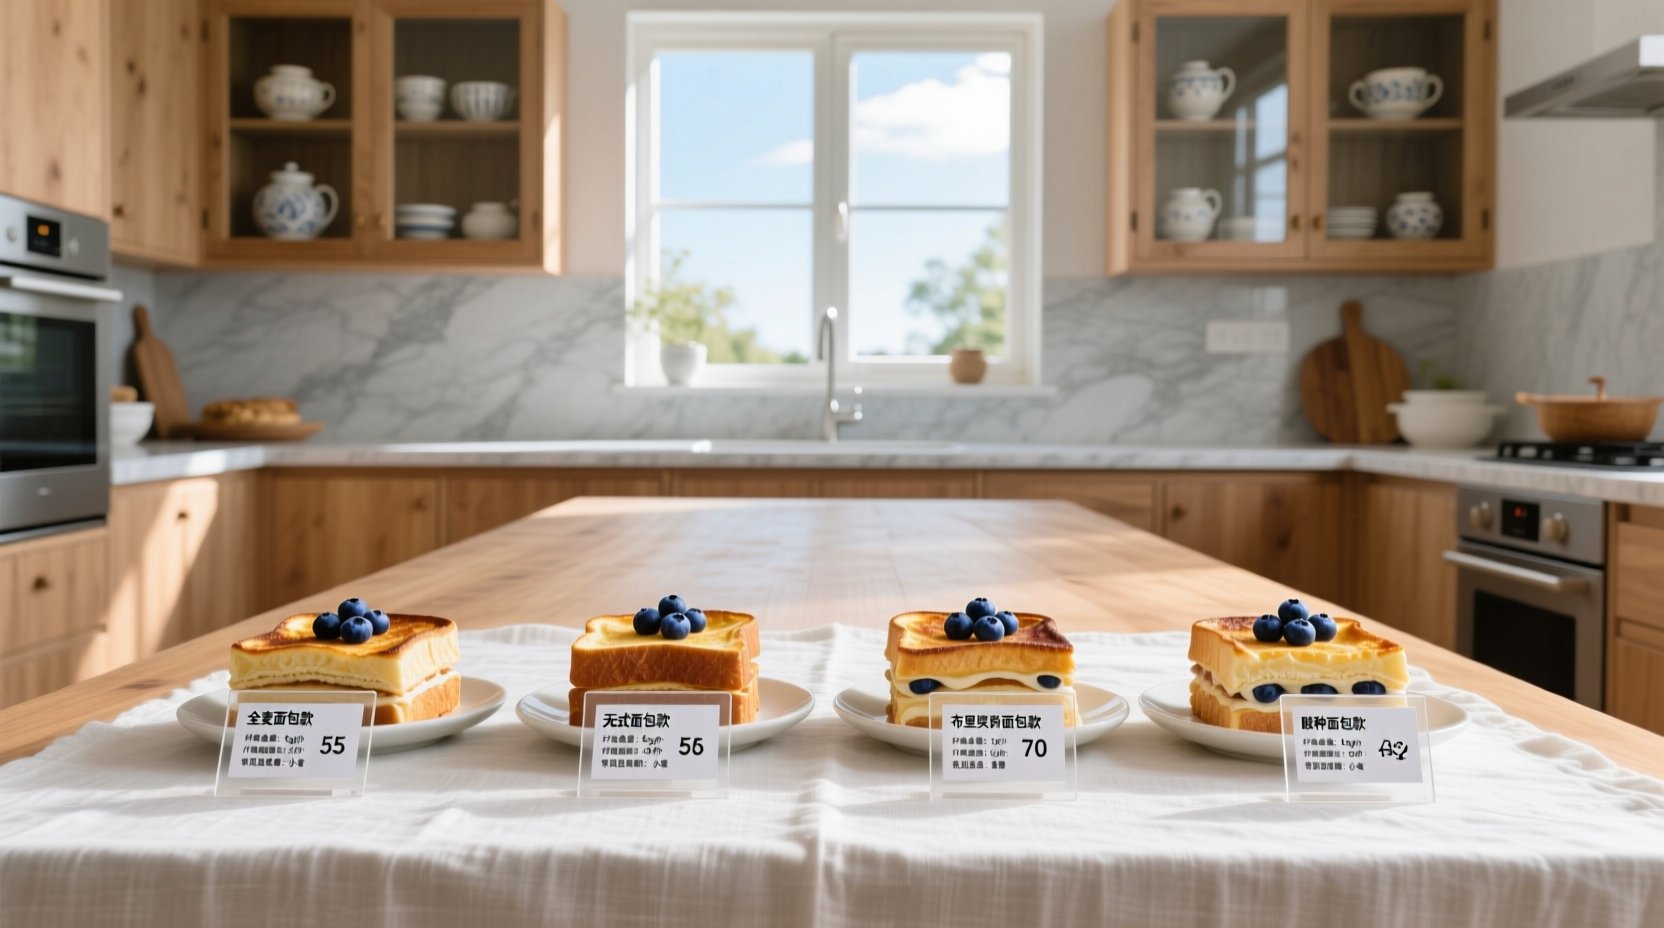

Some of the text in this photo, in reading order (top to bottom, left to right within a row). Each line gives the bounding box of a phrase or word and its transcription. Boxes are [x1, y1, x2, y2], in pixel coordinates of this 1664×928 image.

[246, 710, 314, 727] 全麦面包款
[319, 735, 346, 755] 55
[678, 736, 704, 756] 56
[1021, 738, 1048, 758] 70
